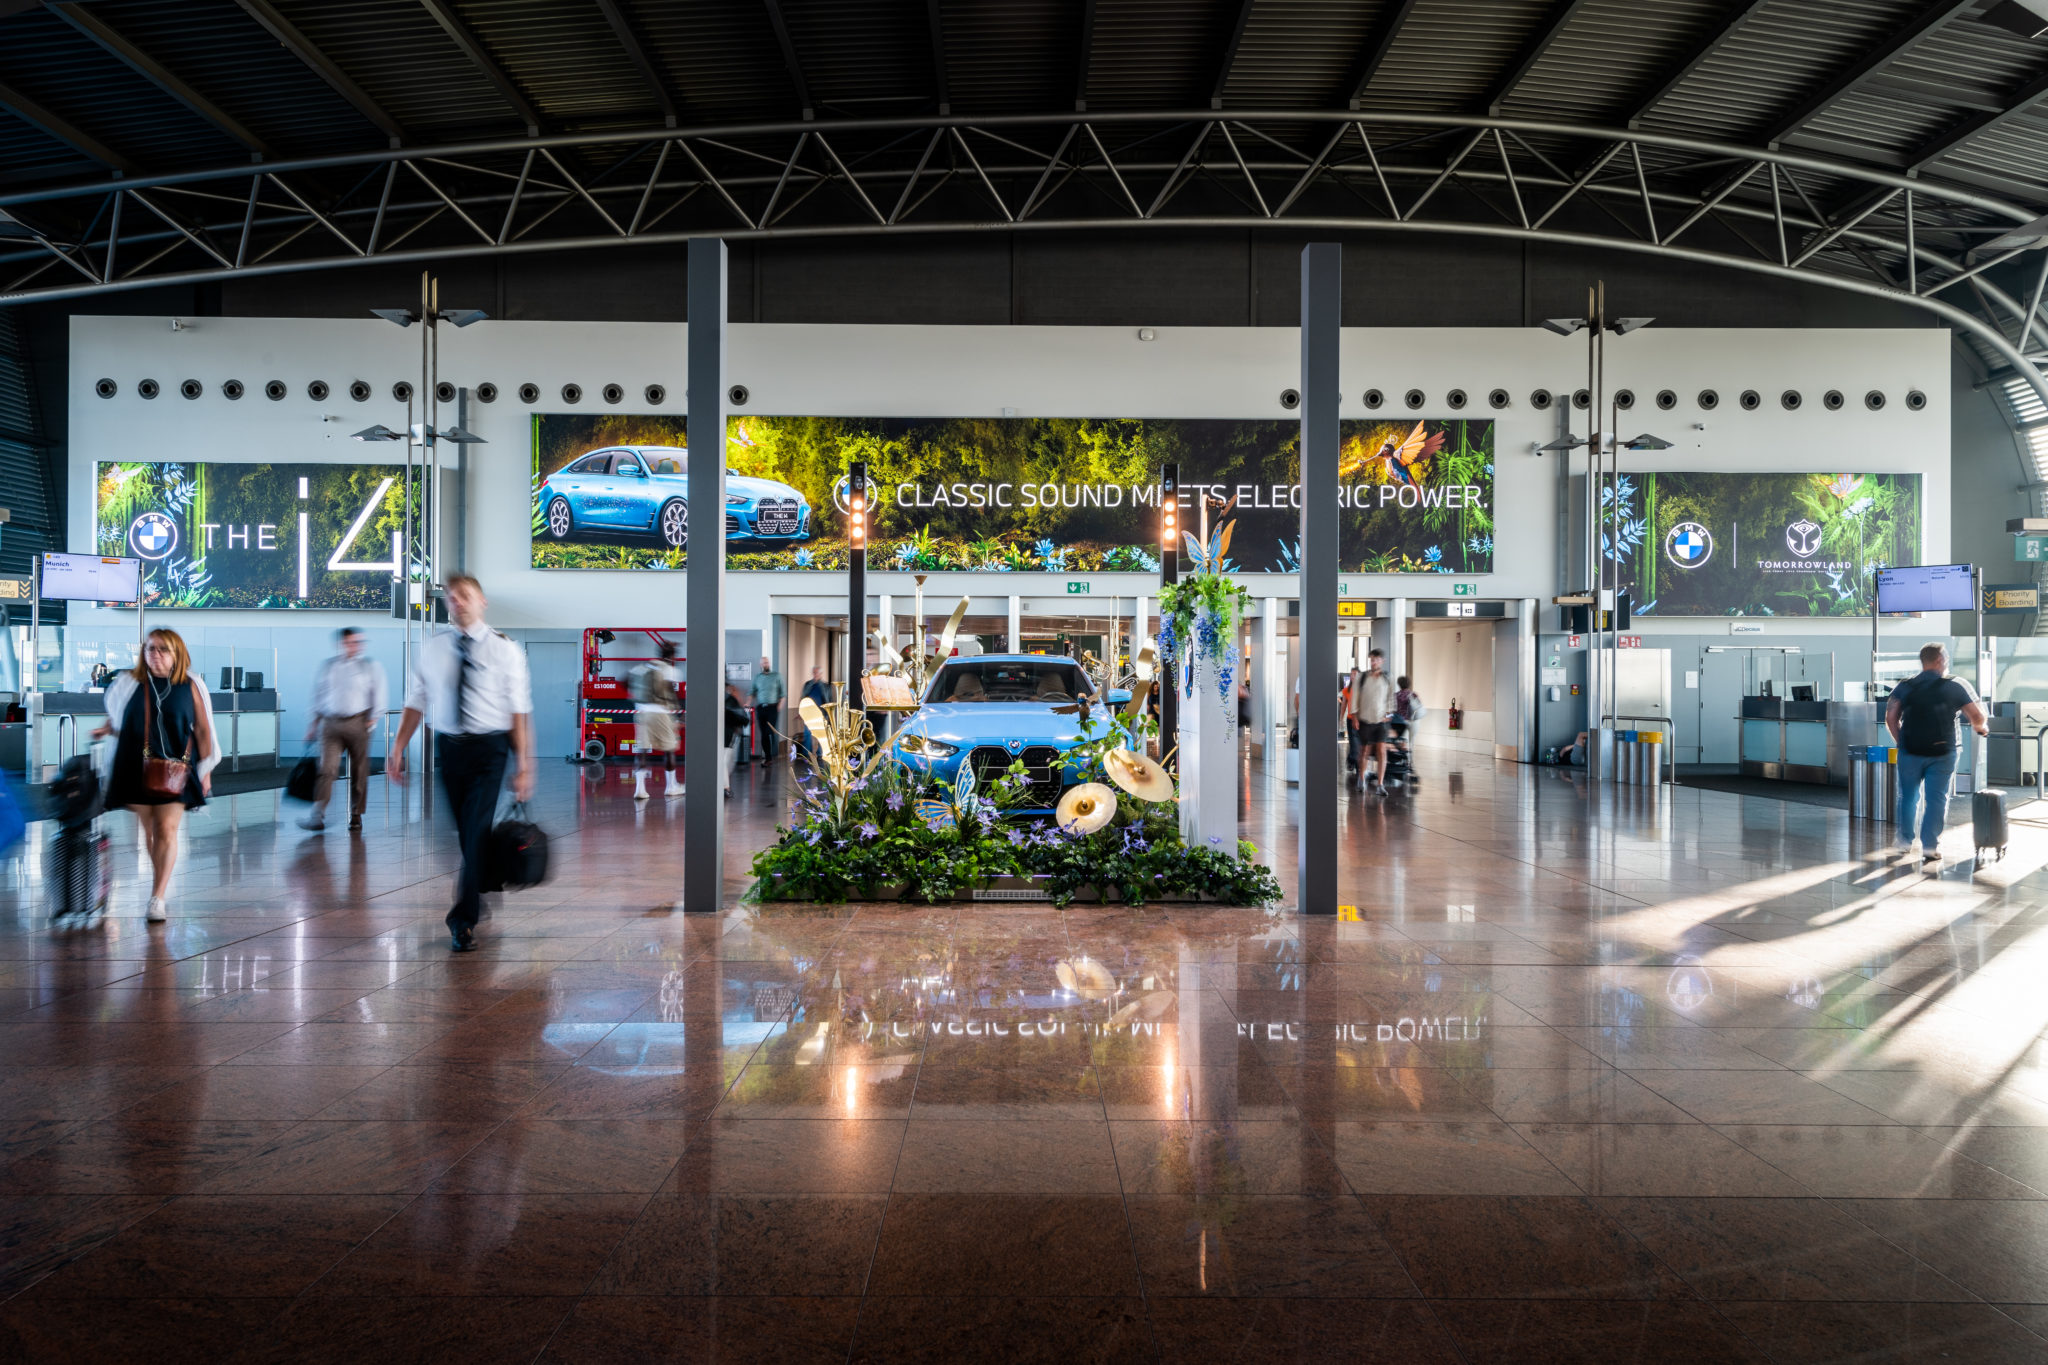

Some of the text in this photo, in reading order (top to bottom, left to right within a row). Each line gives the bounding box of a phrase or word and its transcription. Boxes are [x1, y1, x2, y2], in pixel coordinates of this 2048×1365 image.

[897, 483, 1488, 509] CLASSIC SOUND METS ELECIC POWER.
[136, 515, 171, 529] BMW
[199, 477, 403, 598] THE i4
[1672, 524, 1707, 538] BMW
[1757, 560, 1852, 569] TOMORROWLAND
